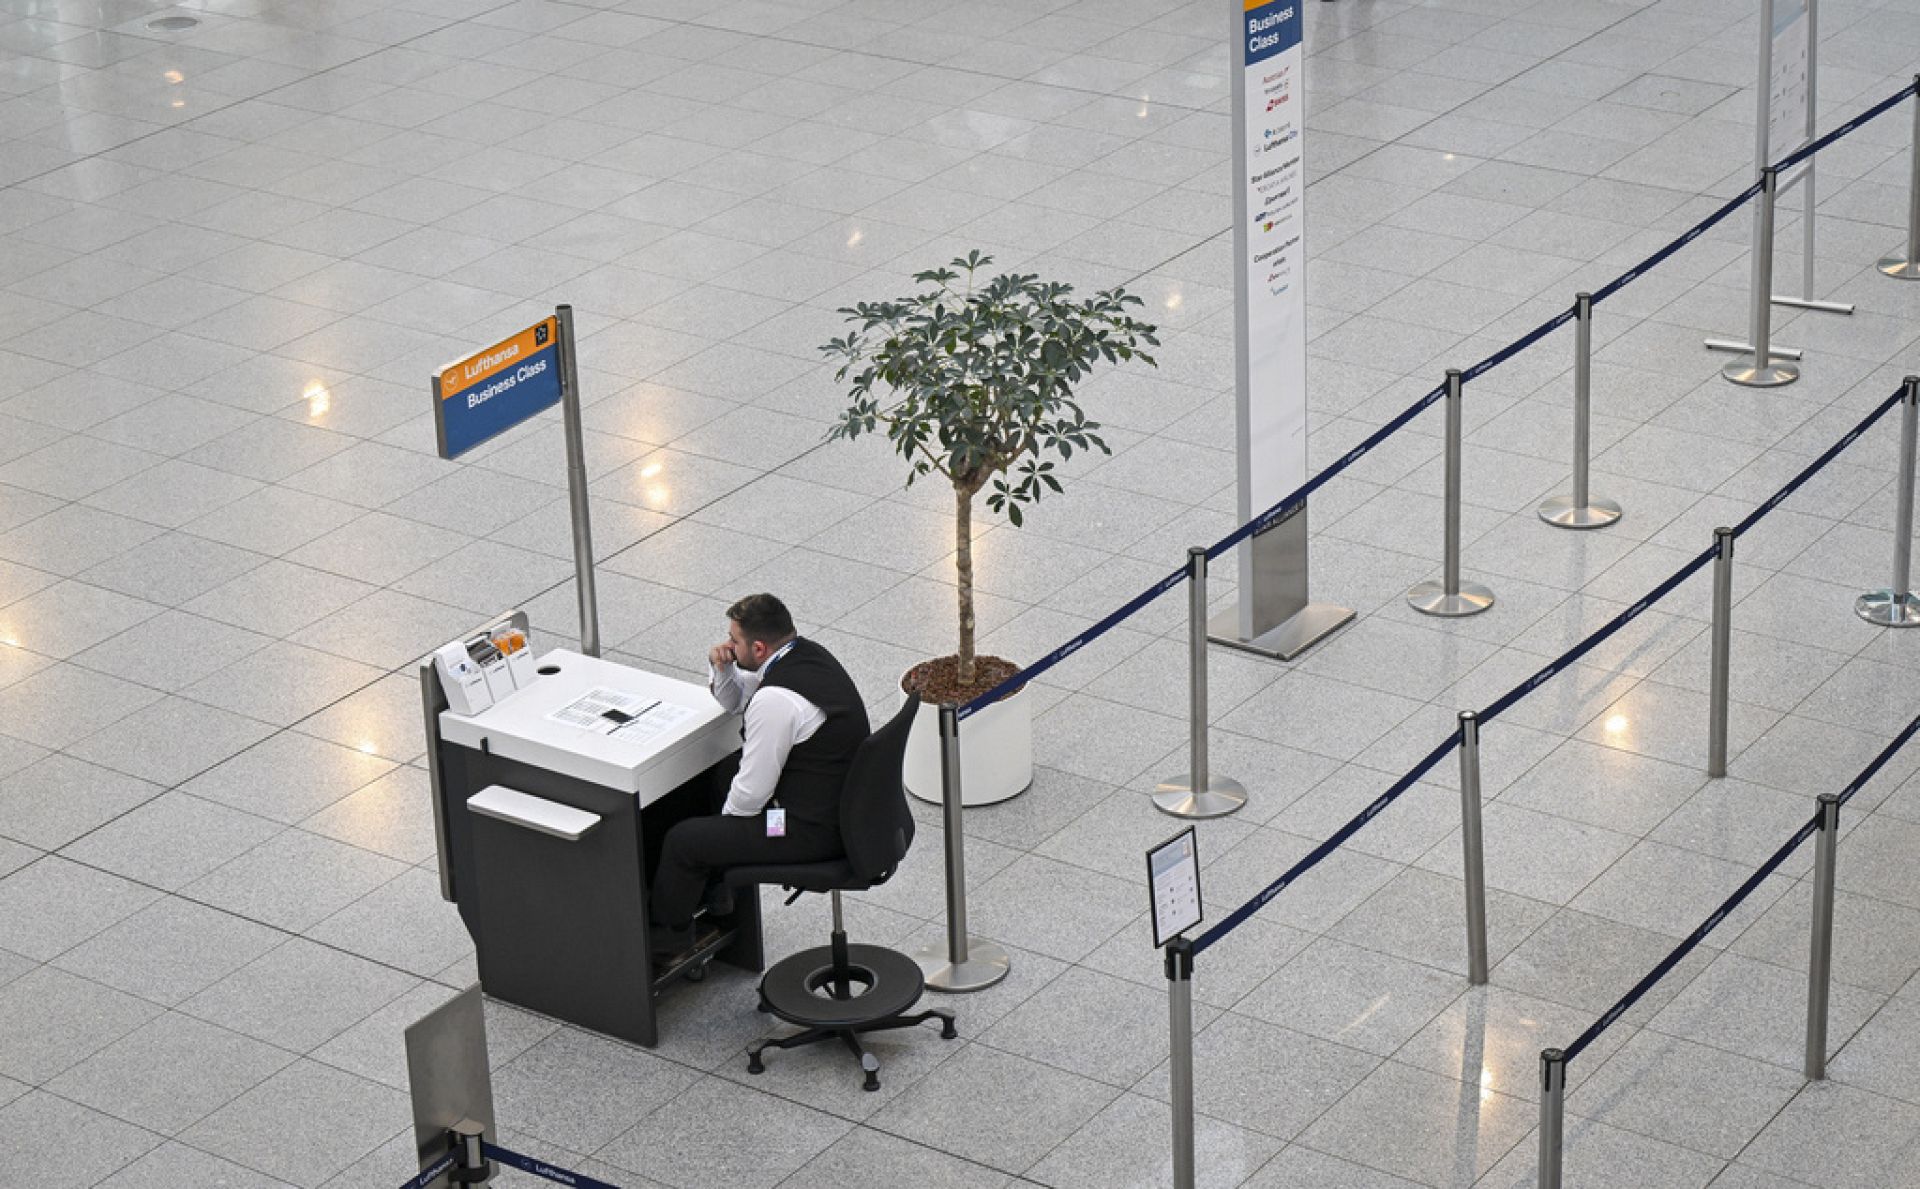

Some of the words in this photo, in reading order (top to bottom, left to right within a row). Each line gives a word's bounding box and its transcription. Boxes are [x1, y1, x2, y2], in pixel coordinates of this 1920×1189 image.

[1249, 7, 1293, 34] Business
[1249, 33, 1279, 52] Class
[464, 345, 519, 379] Lufthansa
[467, 374, 517, 410] Business
[517, 359, 546, 381] Class
[419, 1157, 454, 1186] Lufthansa
[535, 1163, 577, 1185] Lufthansa
